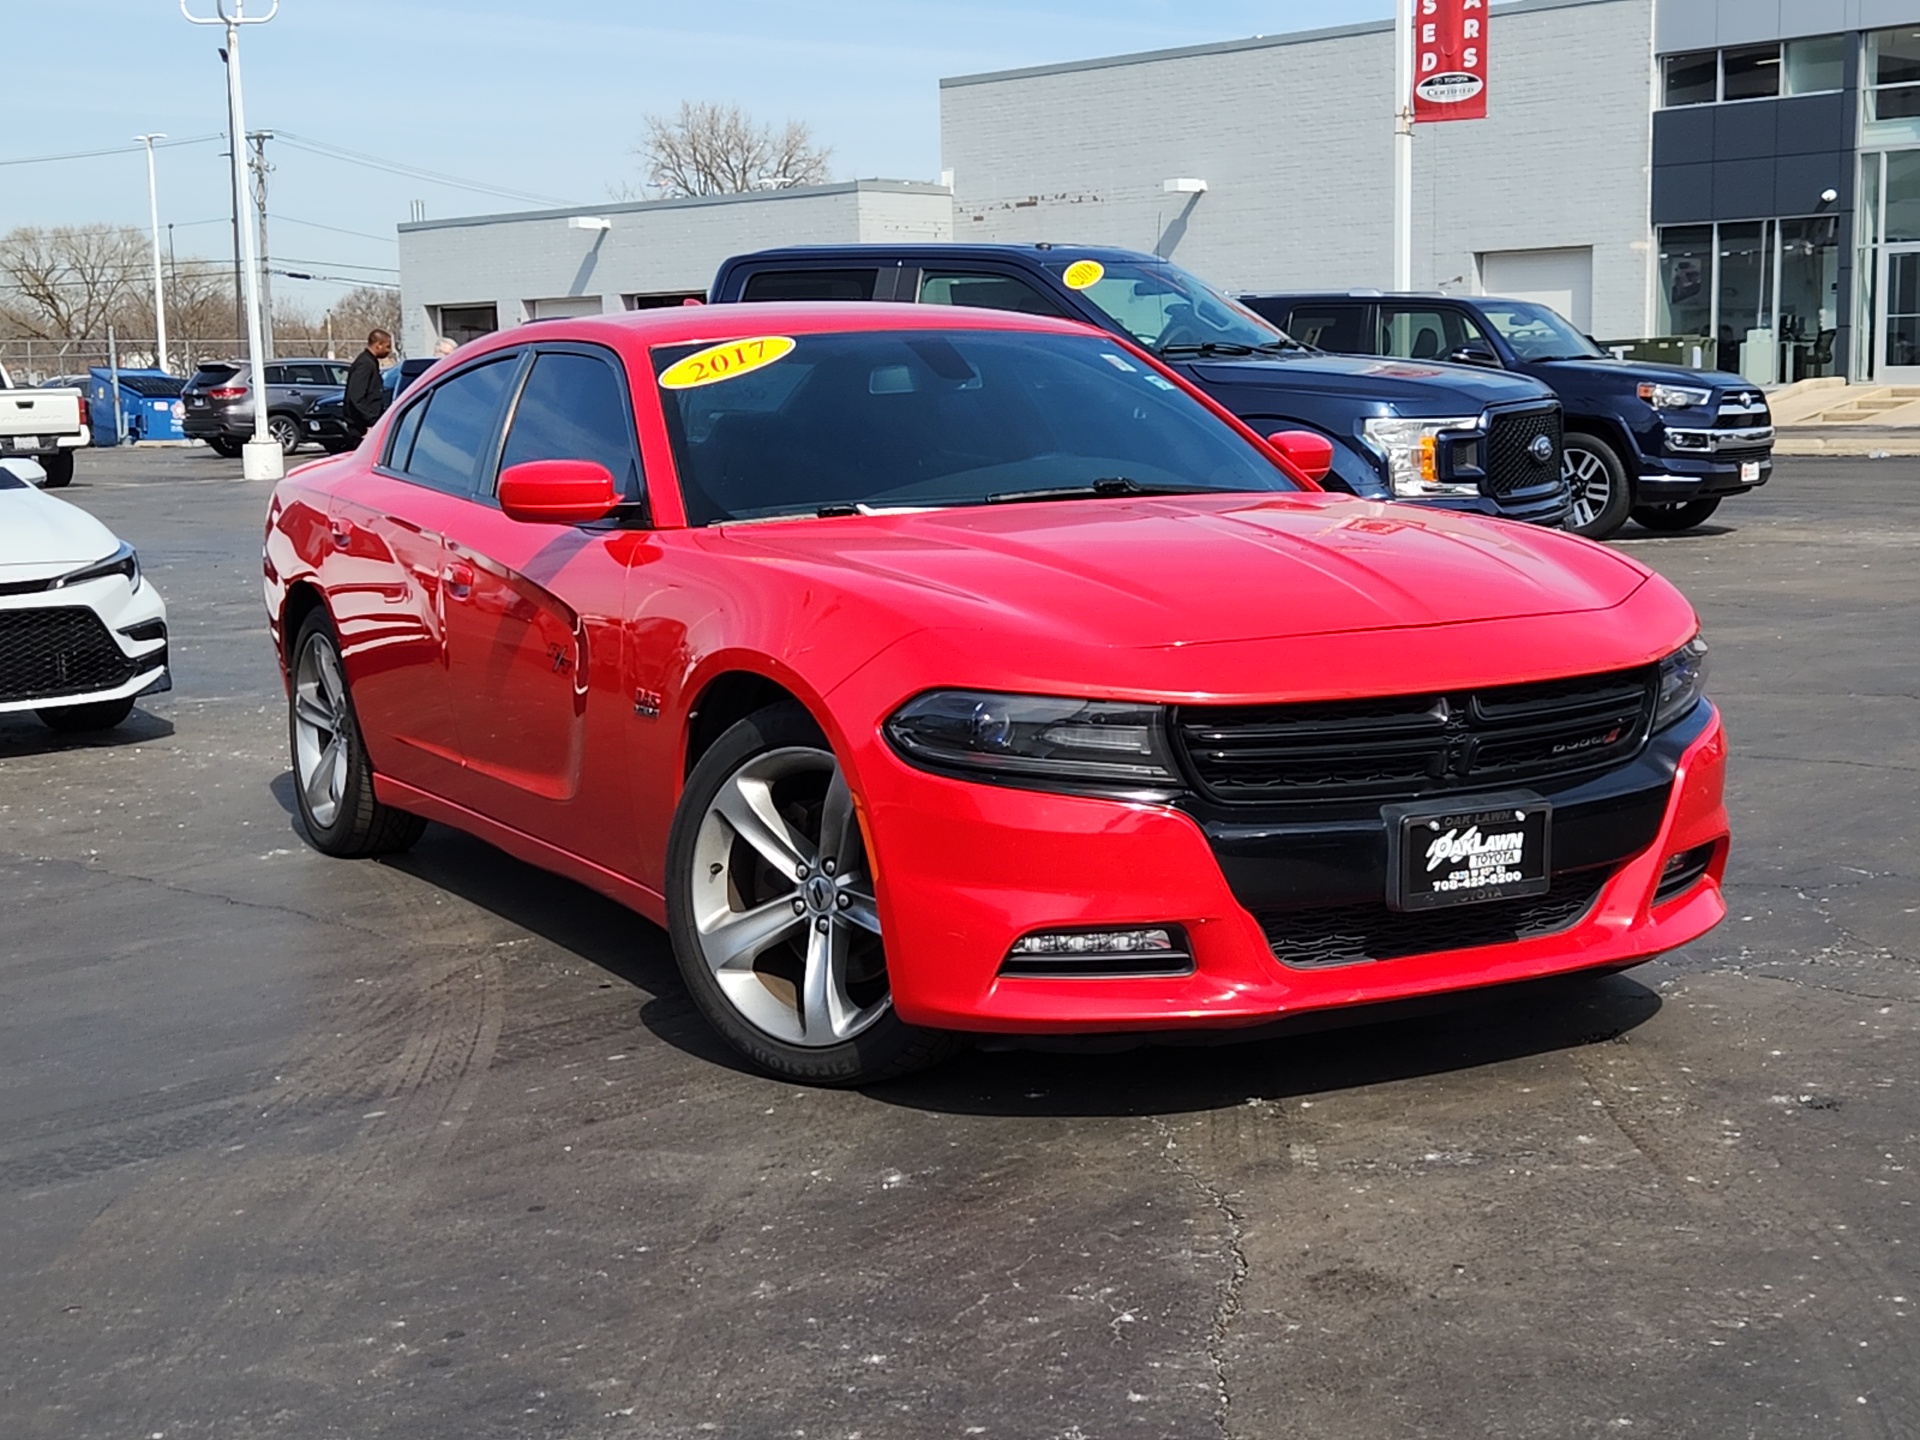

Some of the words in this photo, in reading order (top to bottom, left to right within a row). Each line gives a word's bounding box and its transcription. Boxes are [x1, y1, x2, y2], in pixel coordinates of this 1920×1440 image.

[688, 340, 765, 383] 2017
[1475, 850, 1515, 867] TOYOTA
[1432, 870, 1522, 892] 708-423-5200
